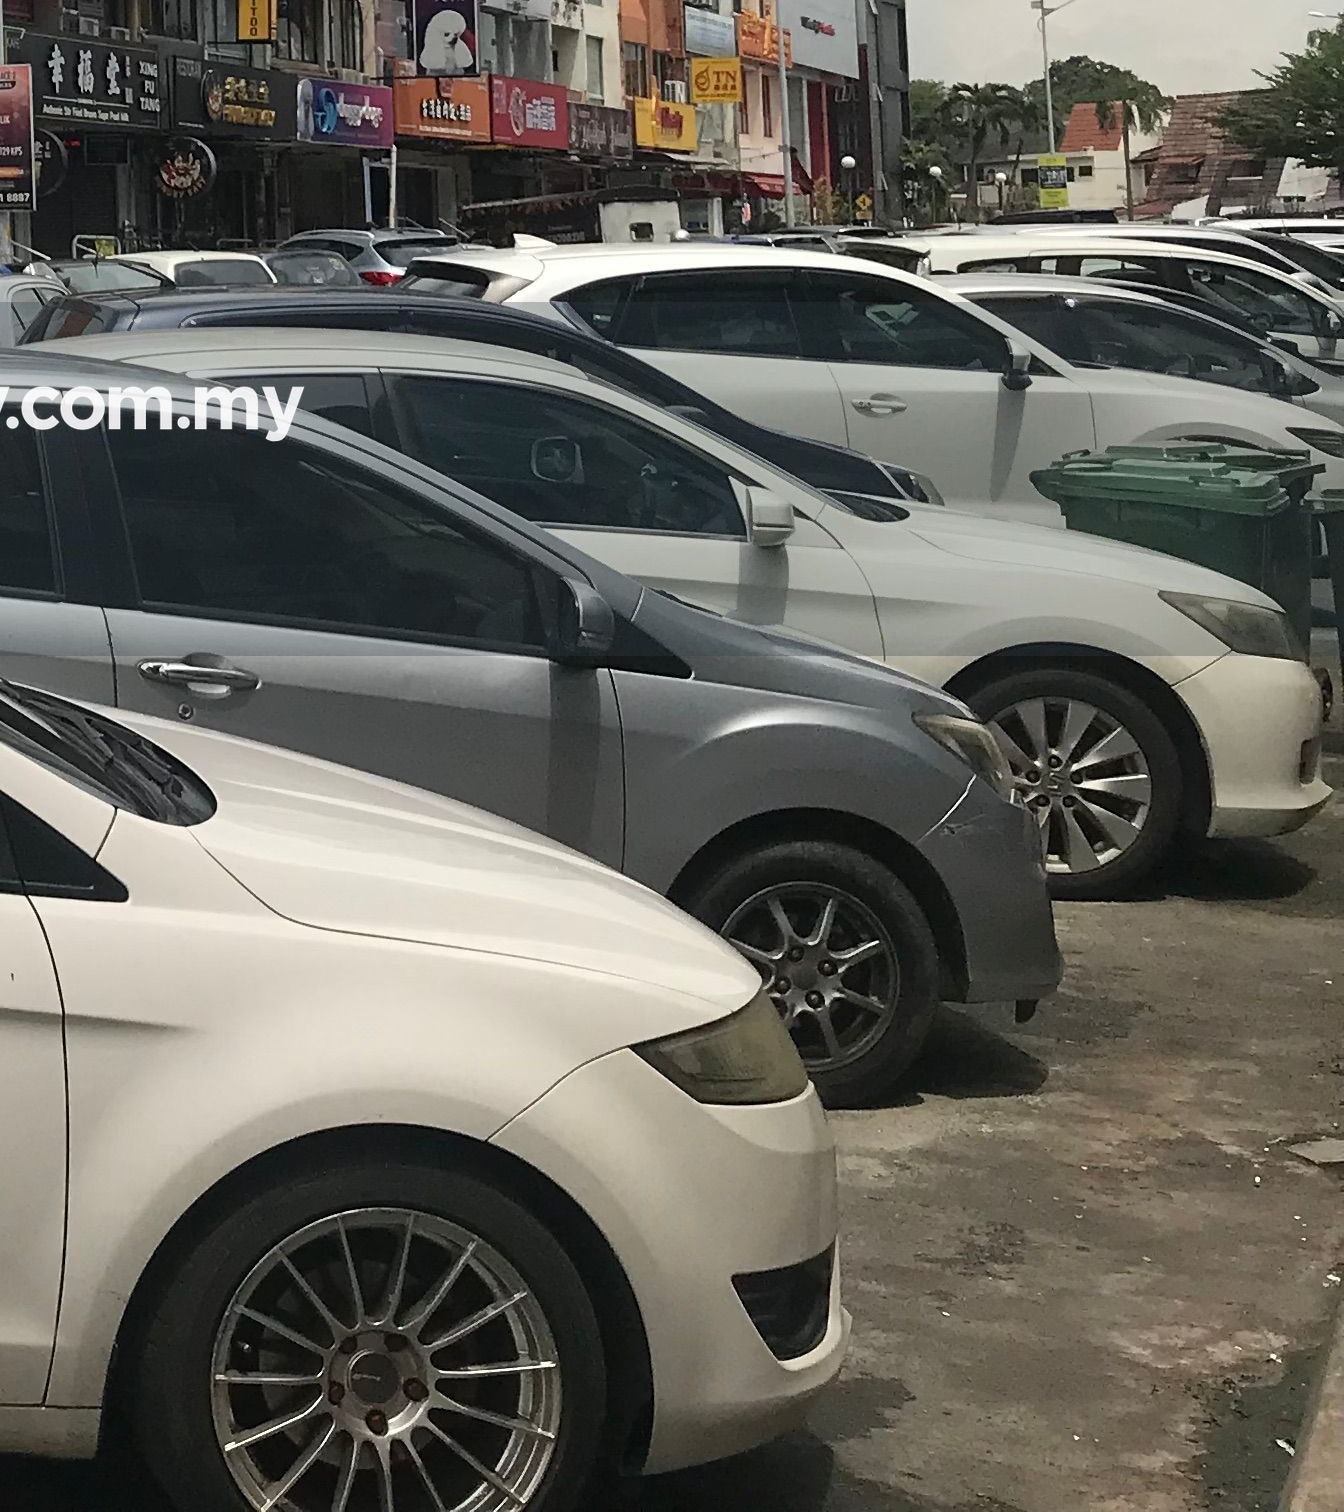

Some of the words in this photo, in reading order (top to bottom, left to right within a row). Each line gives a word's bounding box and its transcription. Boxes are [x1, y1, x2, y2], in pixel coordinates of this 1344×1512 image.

[139, 61, 158, 78] XING
[712, 70, 737, 83] TN
[144, 80, 155, 94] FU
[140, 97, 160, 112] TANG
